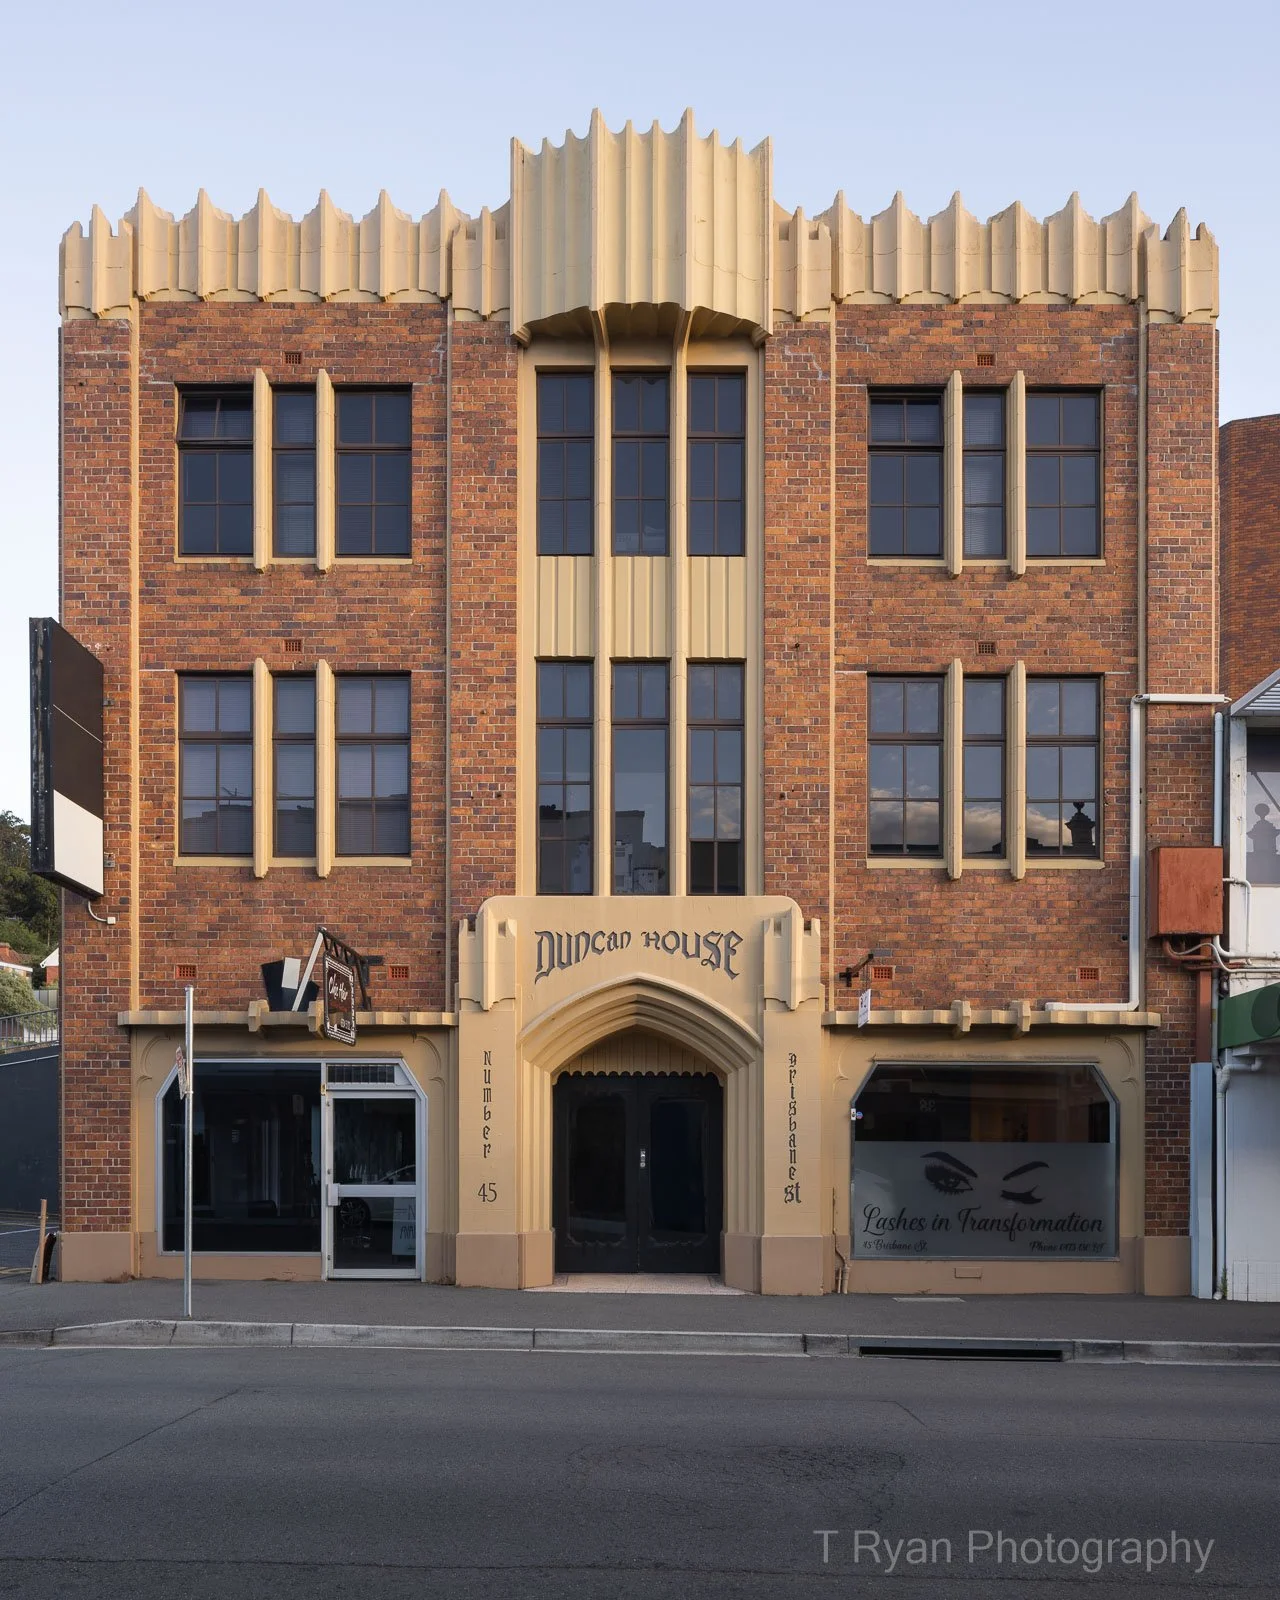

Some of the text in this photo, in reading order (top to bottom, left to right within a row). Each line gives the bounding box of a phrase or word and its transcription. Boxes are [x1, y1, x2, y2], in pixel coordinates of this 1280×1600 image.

[482, 1050, 492, 1159] Number
[477, 1182, 498, 1203] 45
[863, 1203, 1105, 1242] Lashes in Transformation
